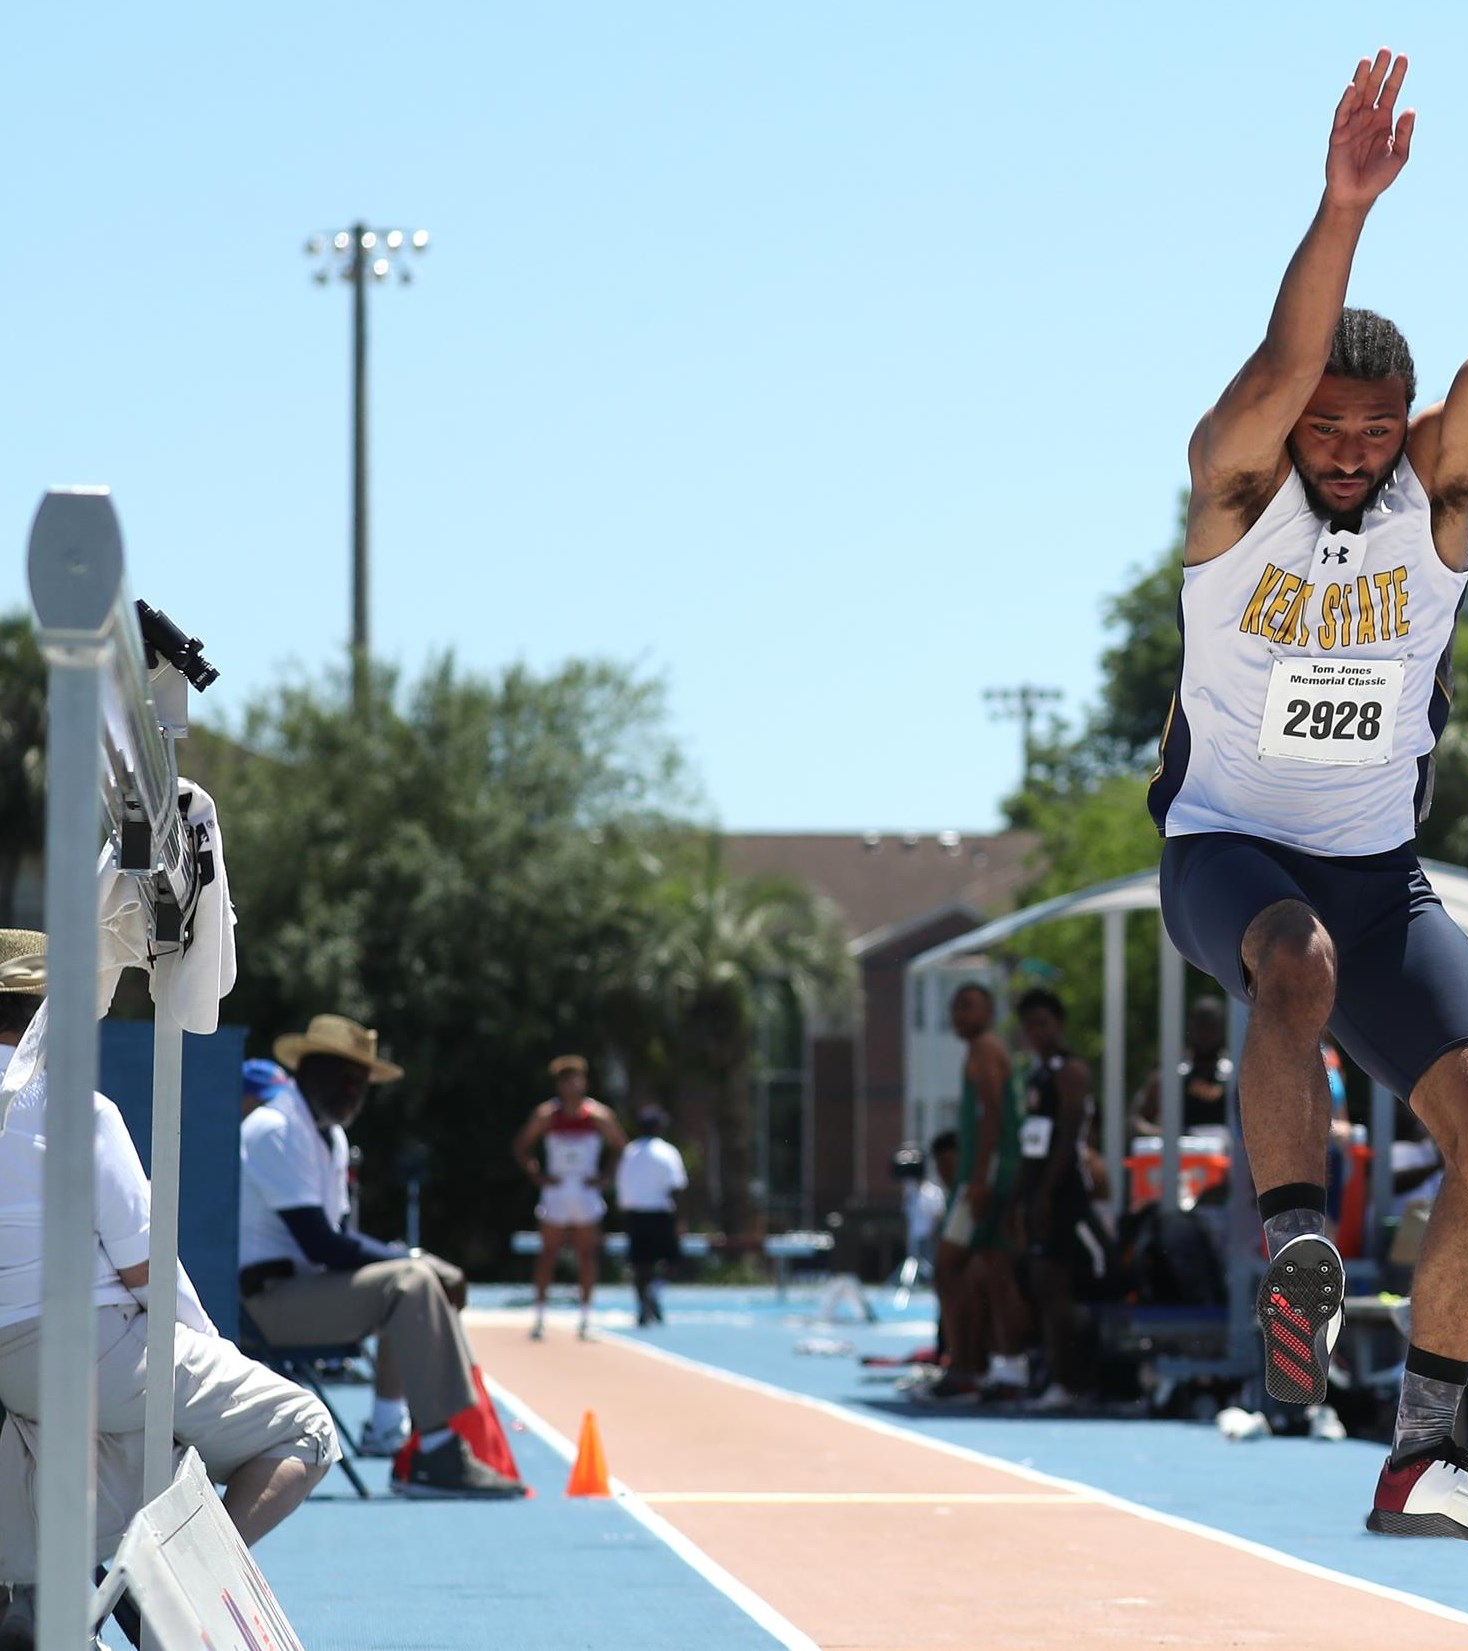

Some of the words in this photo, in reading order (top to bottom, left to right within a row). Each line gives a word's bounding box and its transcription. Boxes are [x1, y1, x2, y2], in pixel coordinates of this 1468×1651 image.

[1317, 565, 1411, 650] STATE
[1290, 674, 1346, 686] Memorial
[1347, 677, 1387, 686] Classic
[1312, 664, 1335, 674] Tom
[1338, 665, 1372, 675] Jones
[1283, 698, 1383, 741] 2928
